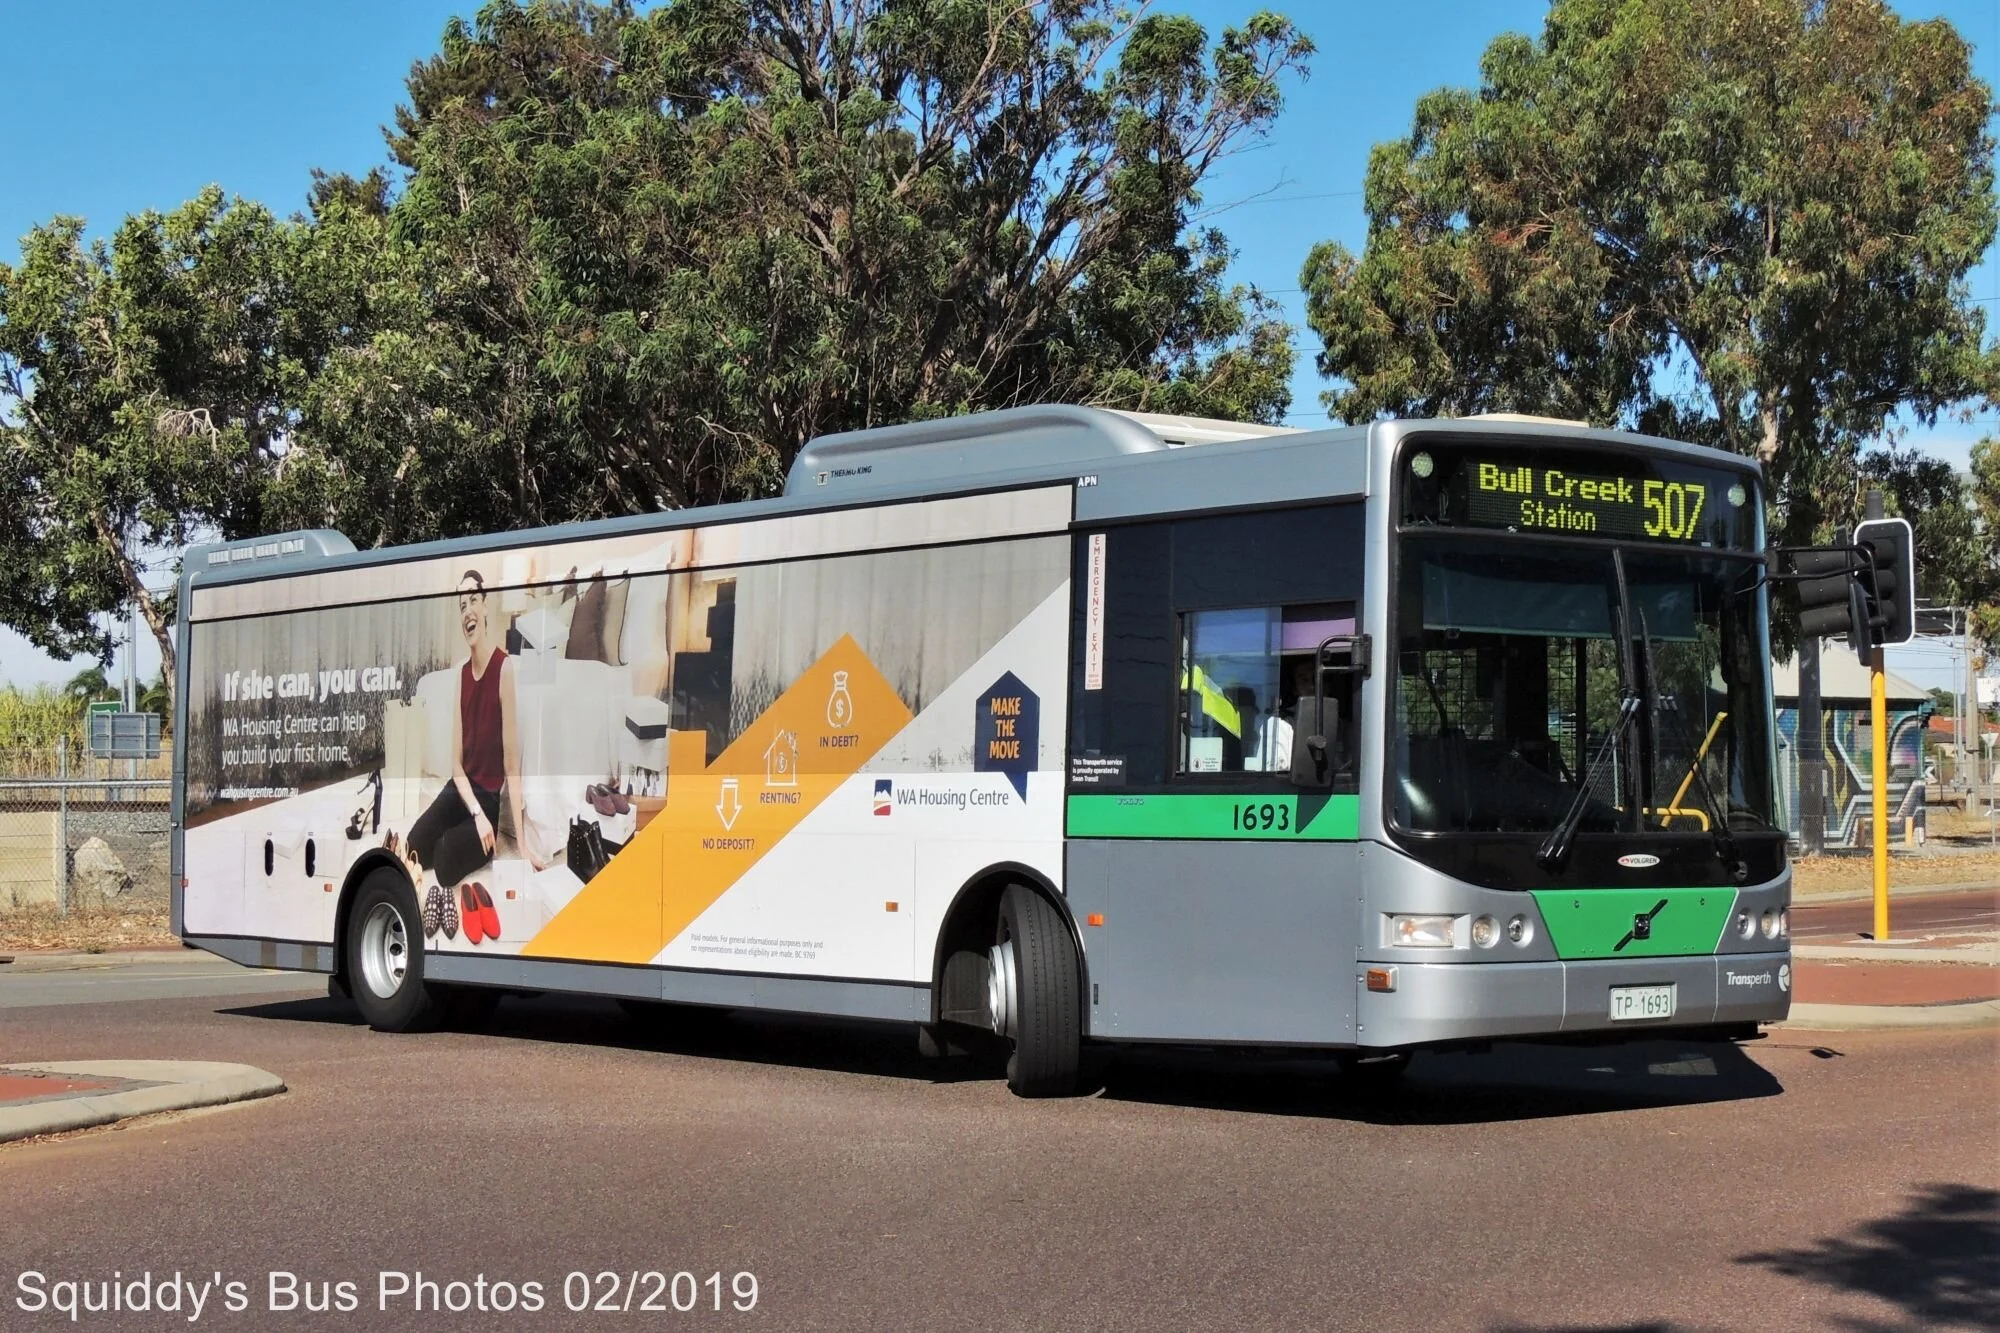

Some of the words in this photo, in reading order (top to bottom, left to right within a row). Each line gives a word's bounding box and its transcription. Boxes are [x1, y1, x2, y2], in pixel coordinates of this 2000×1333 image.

[857, 465, 872, 474] KING
[1077, 475, 1097, 488] APN
[1480, 463, 1532, 494] Bull
[1545, 470, 1633, 503] Creek
[1521, 500, 1596, 531] Station
[1644, 480, 1704, 539] 507
[1092, 536, 1101, 627] EMERGENCY
[1091, 632, 1099, 672] EXIT
[224, 671, 240, 701] If
[242, 670, 273, 700] she
[278, 672, 314, 701] can,
[319, 669, 356, 702] you
[361, 666, 402, 692] can.
[990, 697, 1021, 716] MAKE
[223, 717, 239, 737] WA
[242, 716, 281, 739] Housing
[284, 714, 318, 734] Centre
[320, 716, 339, 733] can
[343, 710, 366, 736] help
[996, 719, 1015, 737] THE
[819, 736, 828, 747] IN
[832, 735, 859, 747] DEBT?
[990, 740, 1020, 759] MOVE
[222, 750, 239, 769] you
[242, 745, 266, 764] build
[269, 748, 292, 769] your
[295, 743, 315, 764] first
[318, 744, 351, 762] home.
[220, 784, 299, 801] wahousingcentre.com.au
[760, 792, 801, 804] RENTING?
[897, 789, 917, 805] WA
[919, 789, 966, 810] Housing
[970, 789, 1009, 805] Centre
[1234, 804, 1289, 830] 1693
[703, 839, 714, 849] NO
[717, 838, 755, 850] DEPOSIT?
[1726, 970, 1771, 988] Transperth
[1616, 994, 1669, 1016] TP-1693
